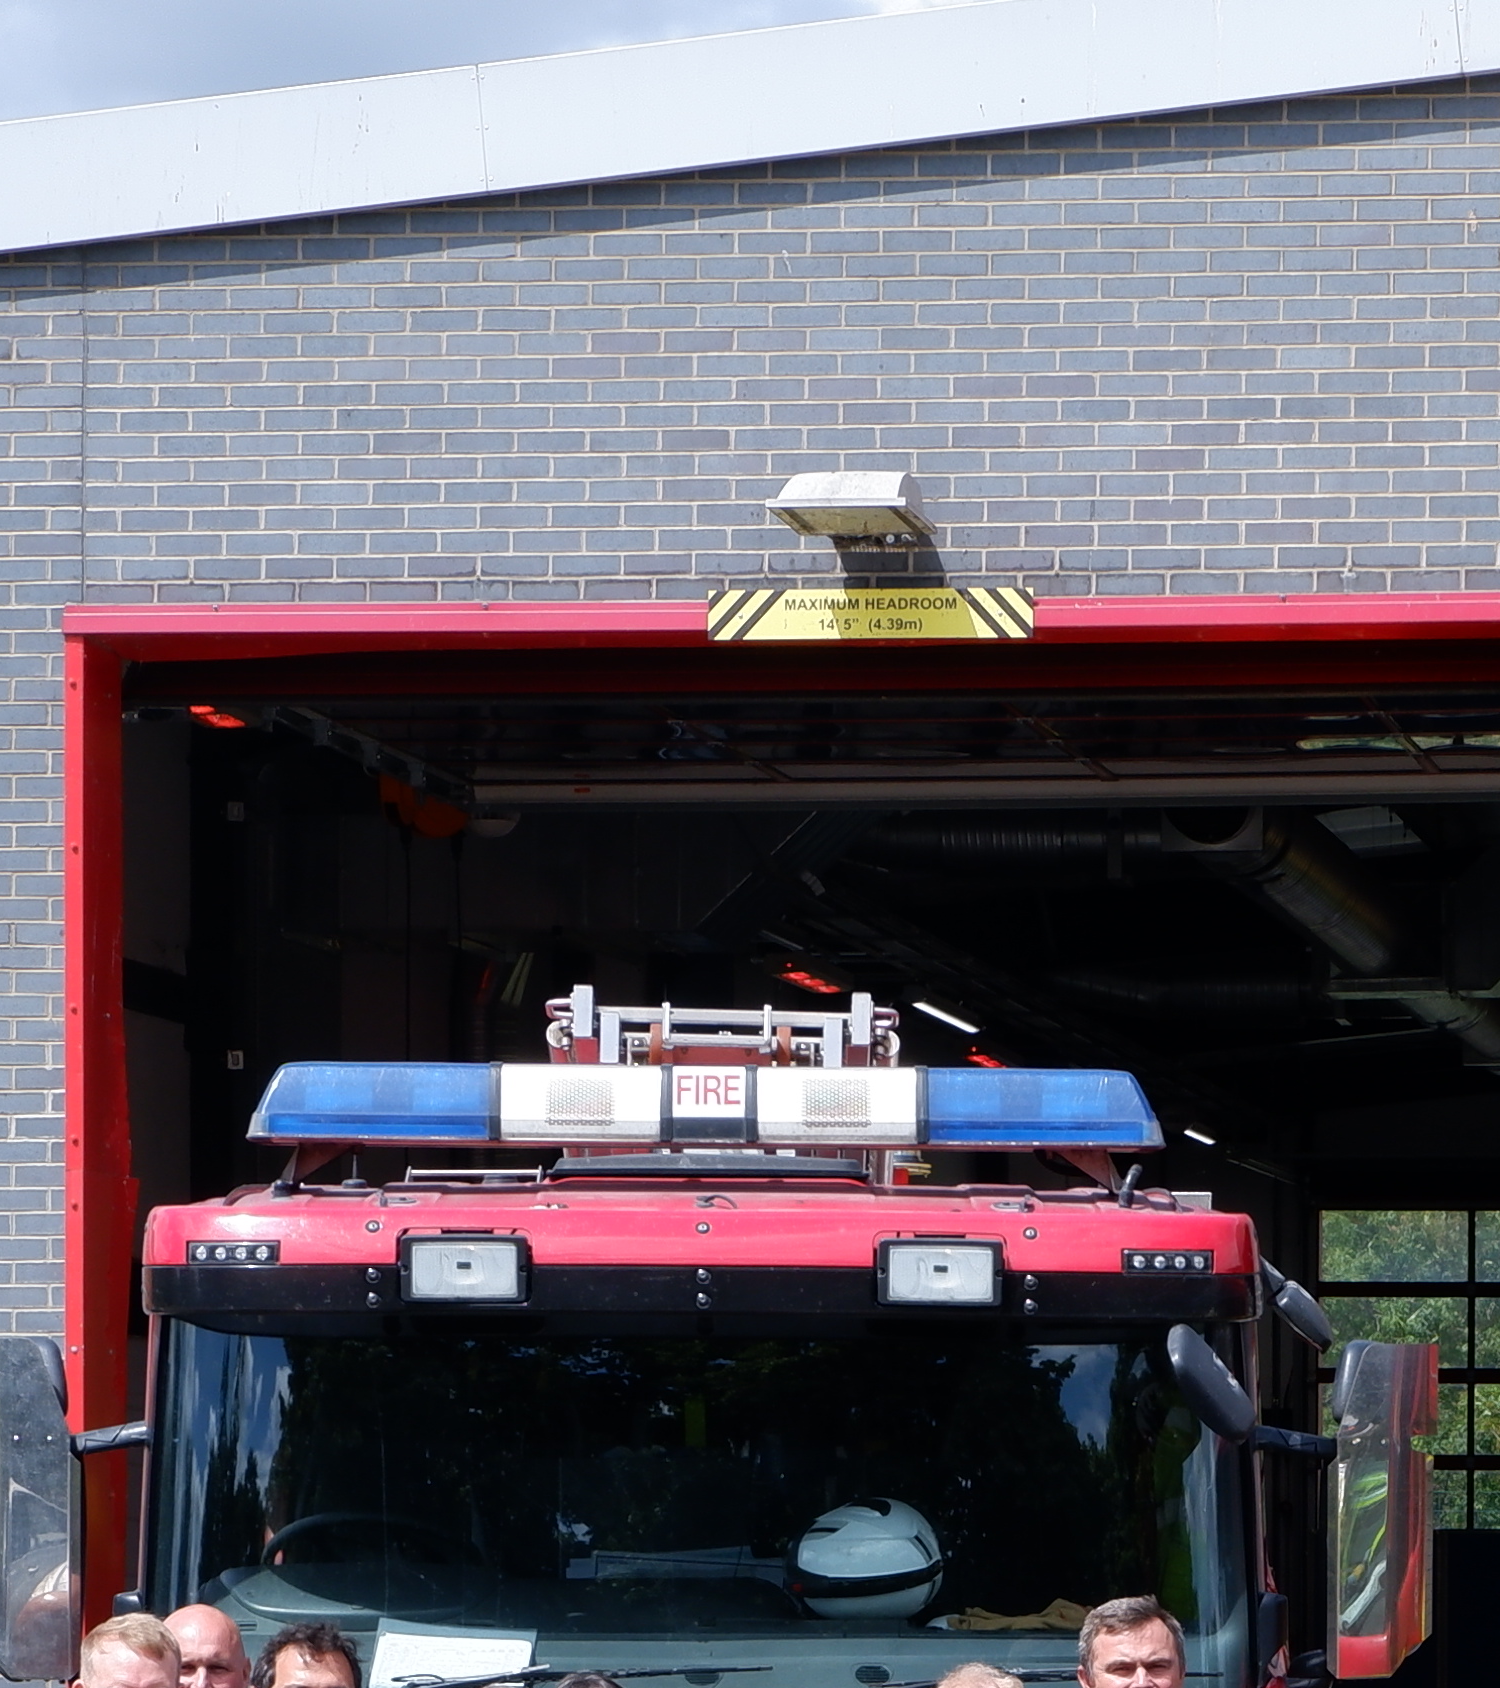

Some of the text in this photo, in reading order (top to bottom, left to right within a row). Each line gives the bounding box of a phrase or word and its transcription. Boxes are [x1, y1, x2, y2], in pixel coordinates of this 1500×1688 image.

[784, 596, 958, 612] MAXIMUM HEADROOM
[868, 617, 923, 633] (4.39m)
[677, 1075, 741, 1105] FIRE
